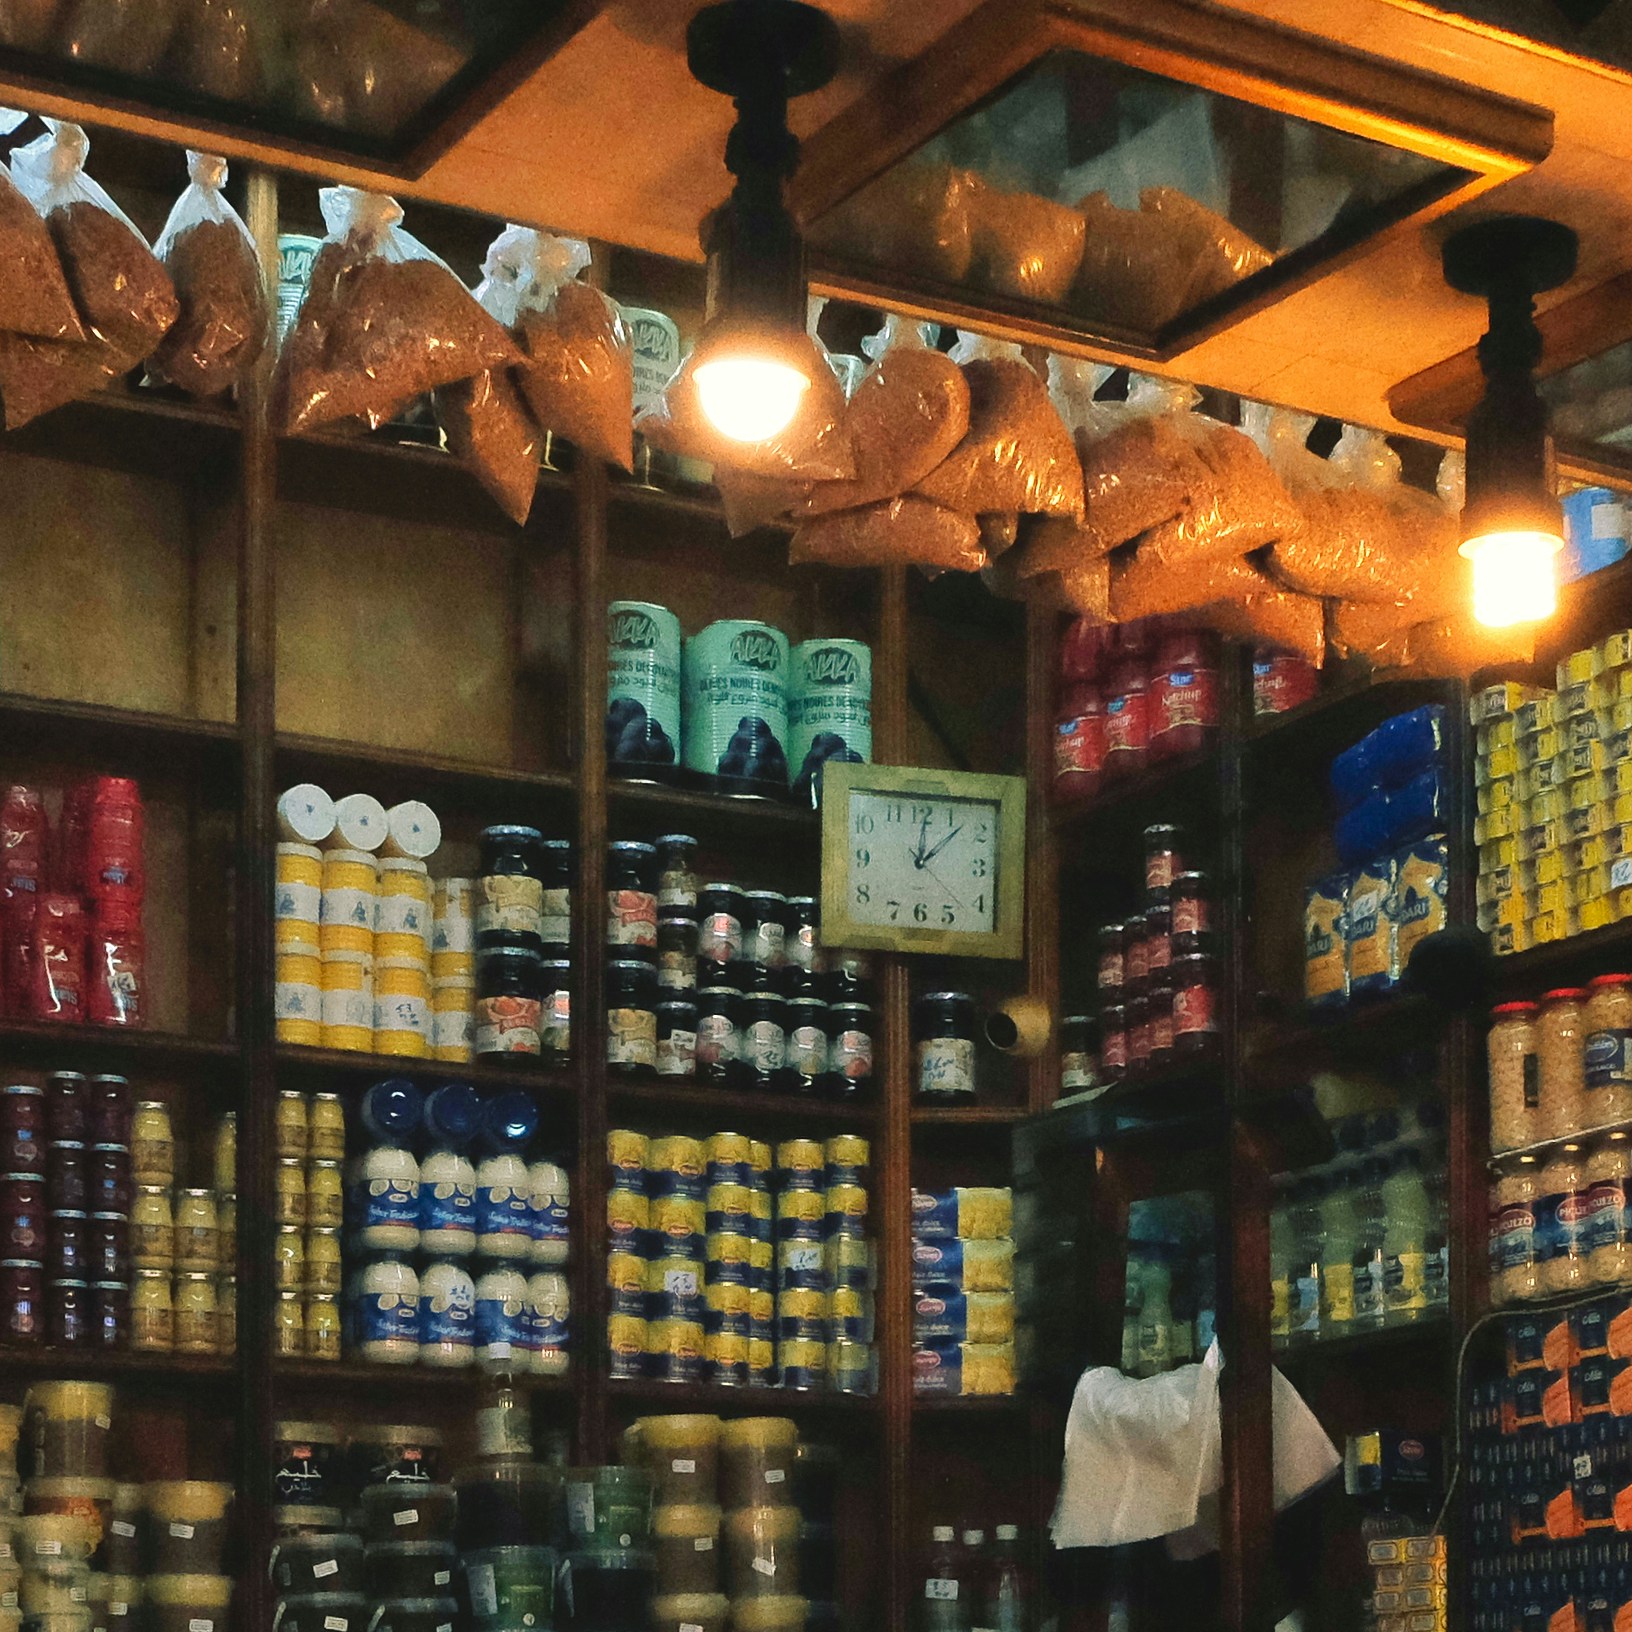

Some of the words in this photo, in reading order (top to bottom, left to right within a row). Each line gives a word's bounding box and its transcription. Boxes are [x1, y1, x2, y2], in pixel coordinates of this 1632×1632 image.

[855, 813, 875, 835] 10
[886, 804, 902, 823] 11
[911, 804, 934, 826] 12
[948, 806, 955, 828] 1
[973, 822, 988, 844] 2
[856, 848, 871, 869] 9
[972, 857, 987, 878] 3
[856, 884, 871, 905] 8
[971, 893, 985, 914] 4
[886, 900, 901, 921] 7
[913, 902, 928, 923] 6
[940, 903, 956, 925] 5
